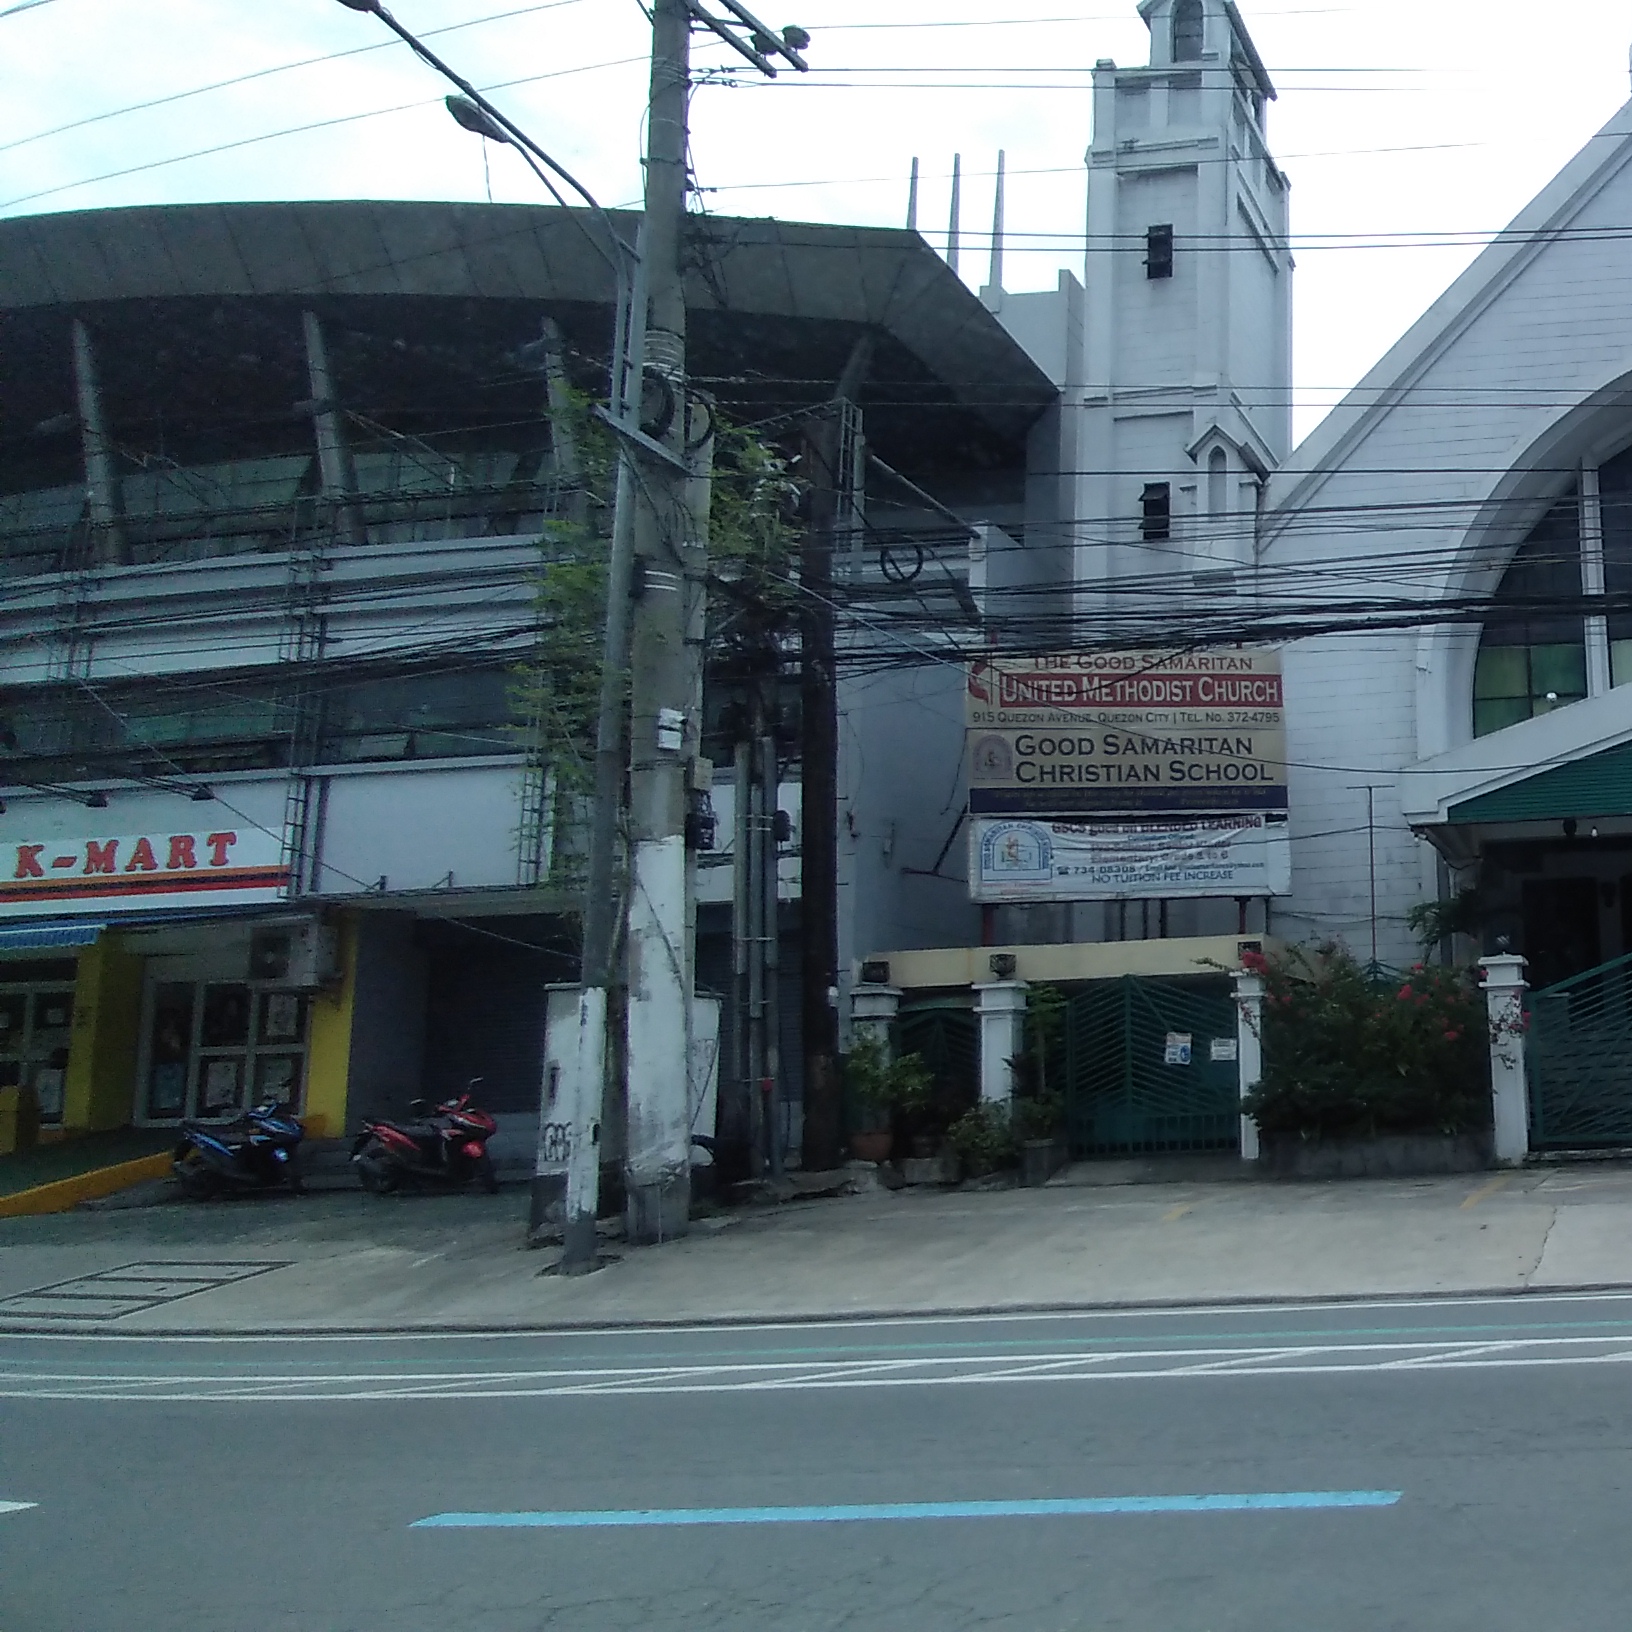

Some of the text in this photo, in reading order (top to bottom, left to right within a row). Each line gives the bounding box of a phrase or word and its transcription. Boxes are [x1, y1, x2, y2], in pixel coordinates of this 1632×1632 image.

[1078, 654, 1135, 670] GOOD
[1141, 654, 1252, 670] SAMARITAN
[1002, 675, 1278, 702] UNITED METHODIST CHURCH
[973, 711, 995, 723] 915
[998, 711, 1044, 723] QUEZON
[1098, 711, 1143, 723] QUEZON
[1146, 711, 1170, 723] CITY
[1227, 712, 1280, 723] 372-4795
[1015, 733, 1253, 756] GOOD SAMARITAN
[1015, 760, 1274, 783] CHRISTIAN SCHOOL
[14, 831, 238, 879] K-MART
[1092, 874, 1110, 884] NO
[1184, 870, 1234, 881] INCREASE
